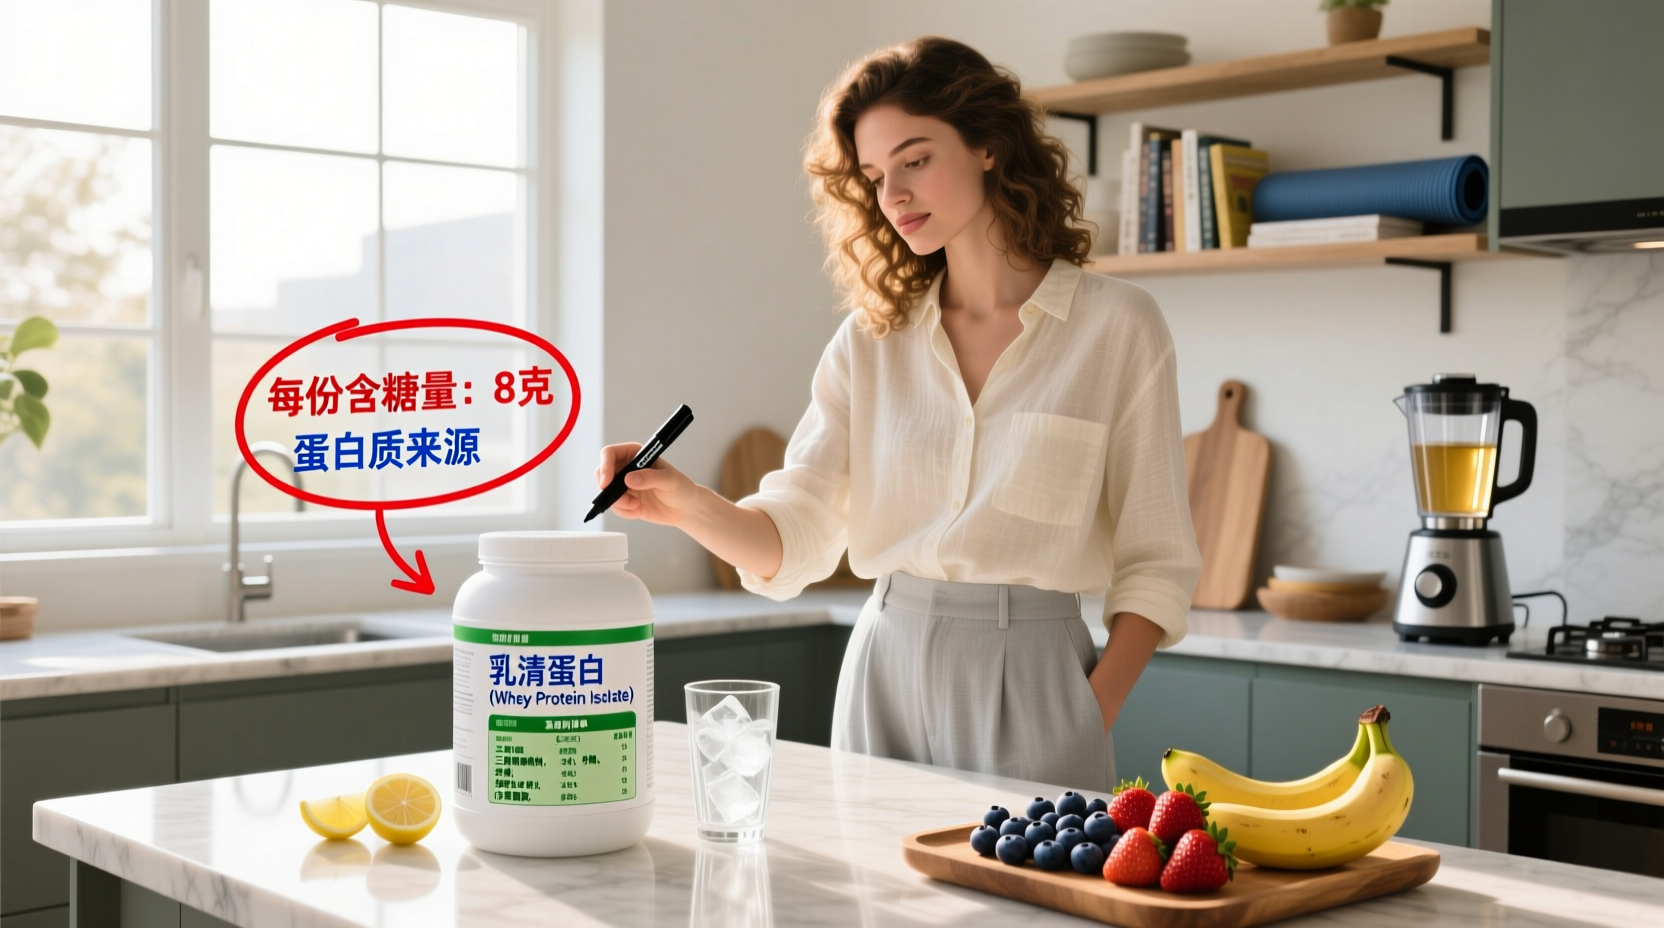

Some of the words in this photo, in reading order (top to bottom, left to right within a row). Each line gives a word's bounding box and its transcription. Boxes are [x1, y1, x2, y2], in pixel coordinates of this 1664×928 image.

[489, 654, 603, 687] 乳清蛋白
[489, 689, 532, 709] (Whey
[536, 690, 586, 705] Protein
